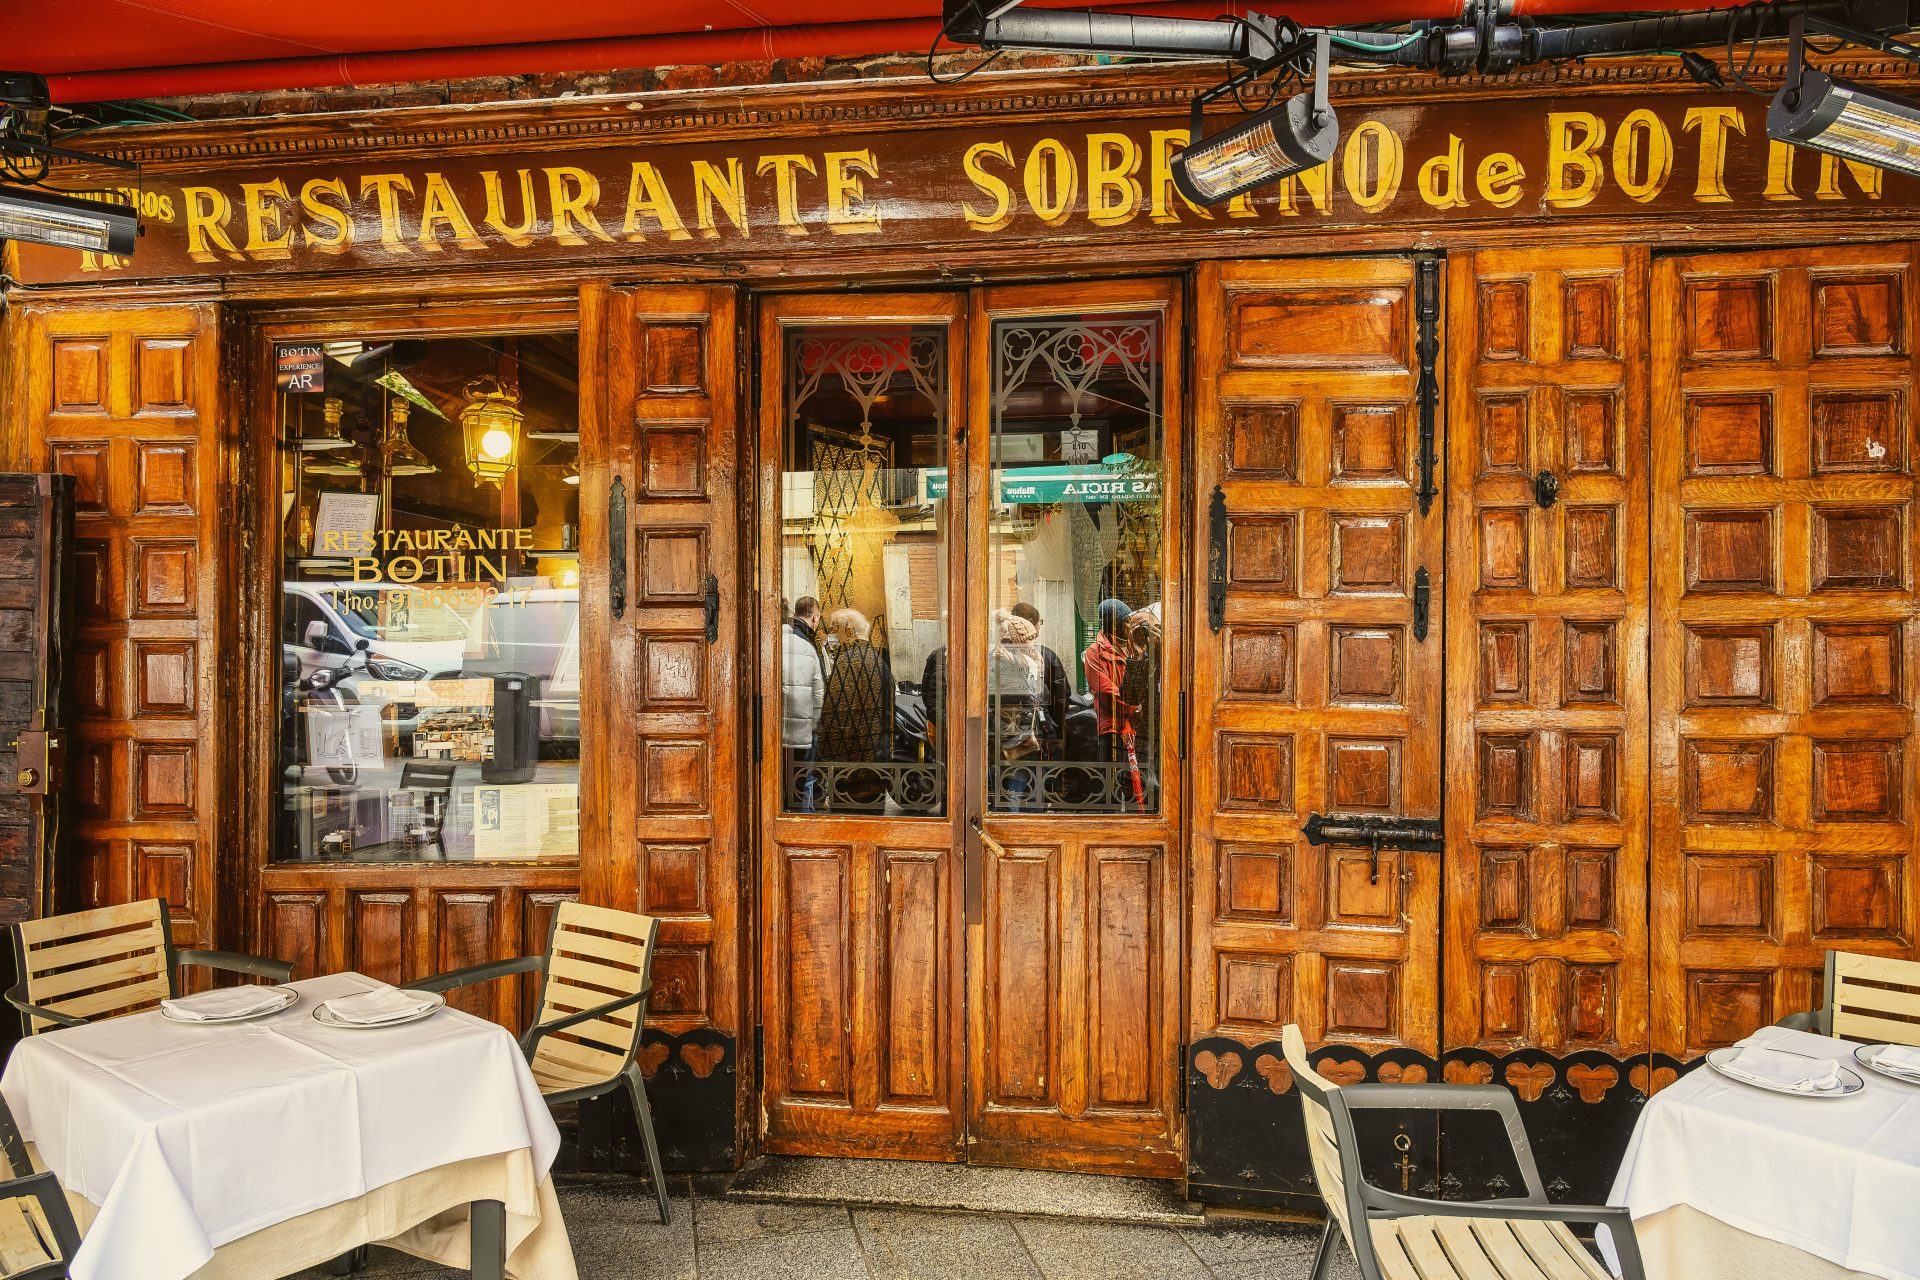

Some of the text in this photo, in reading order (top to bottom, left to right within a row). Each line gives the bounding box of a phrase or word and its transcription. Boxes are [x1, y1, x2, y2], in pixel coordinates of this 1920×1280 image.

[180, 148, 882, 262] RESTAURANTE
[962, 120, 1404, 232] SOBRNO
[1418, 133, 1526, 209] de
[279, 346, 321, 358] BOTIN
[279, 362, 321, 371] EXPERIENCE
[288, 374, 313, 389] AR
[324, 528, 535, 552] RESTAURANTE
[353, 555, 508, 583] BOTIN
